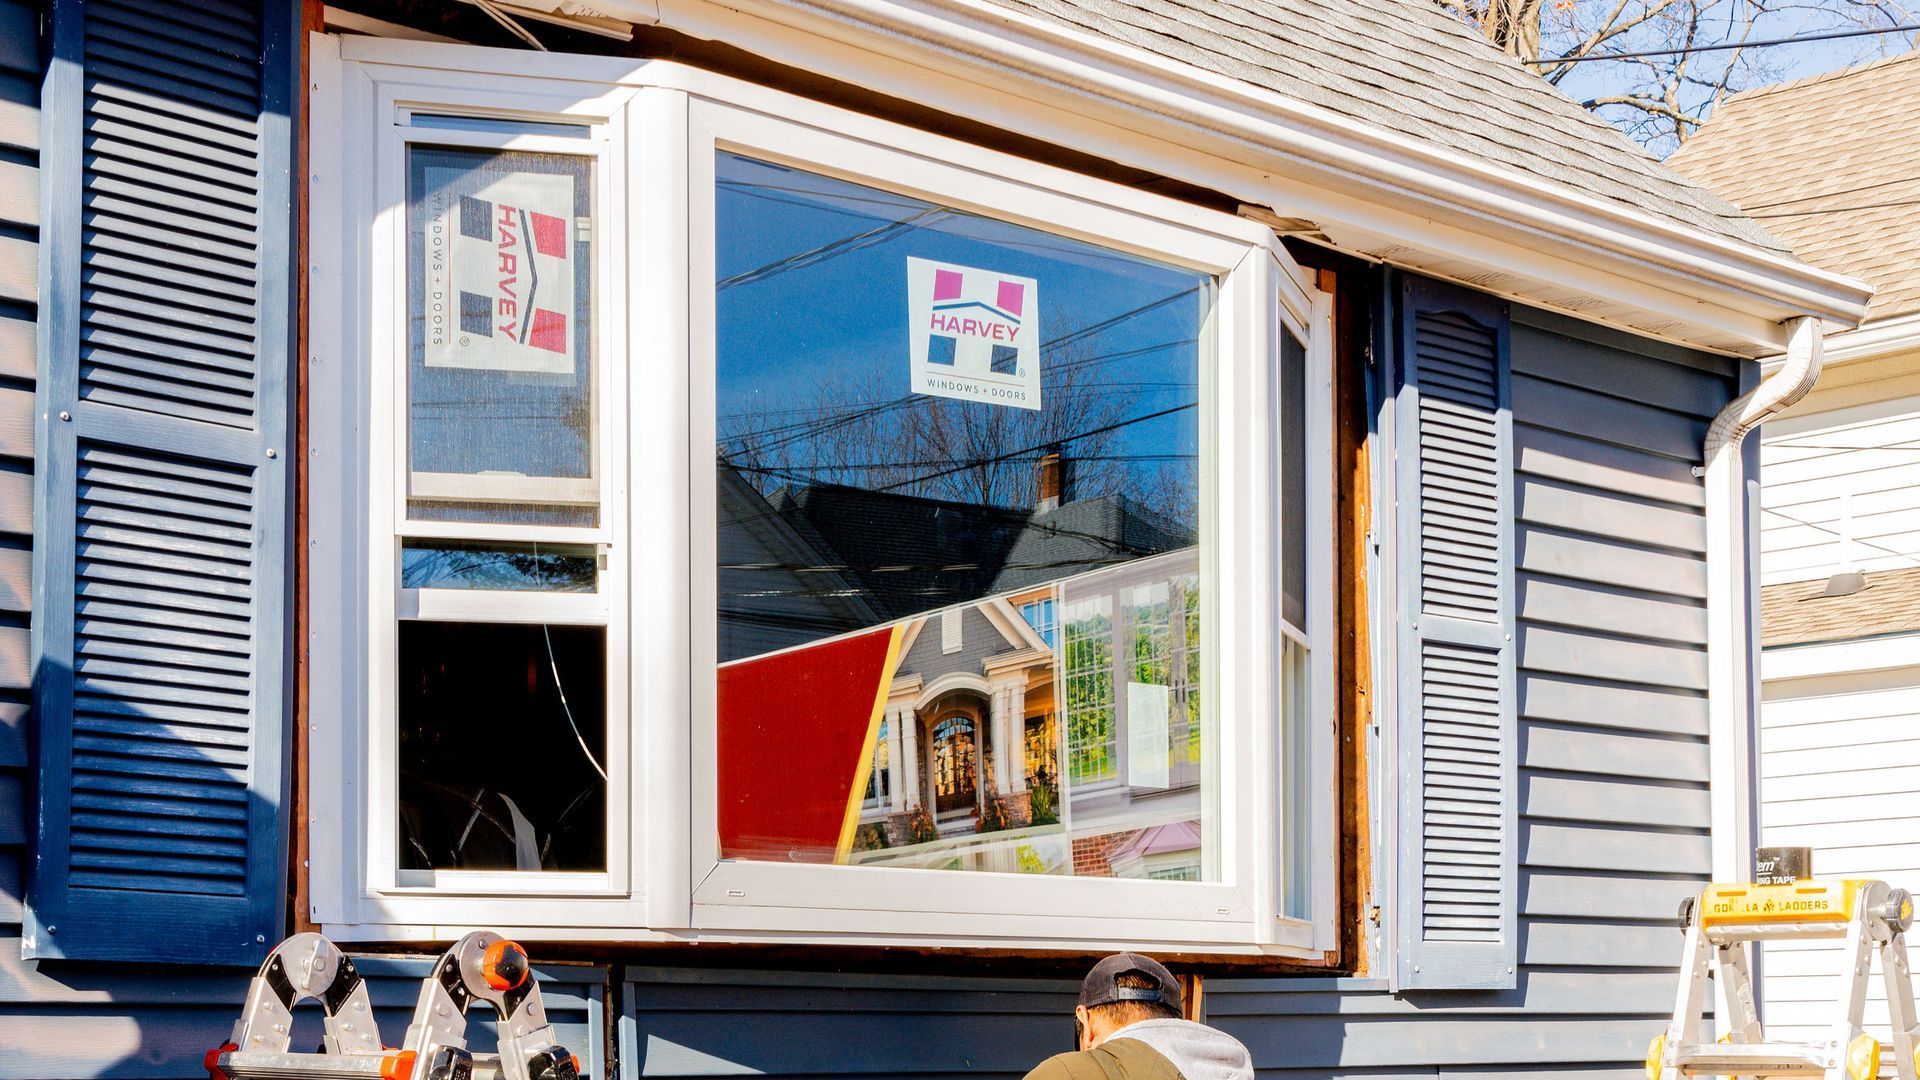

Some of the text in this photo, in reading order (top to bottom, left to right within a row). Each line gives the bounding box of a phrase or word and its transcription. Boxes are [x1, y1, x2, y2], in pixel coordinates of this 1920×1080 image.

[432, 192, 443, 270] WINDOWS
[498, 204, 517, 342] HARVEY
[432, 292, 443, 344] DOORS
[930, 313, 1020, 342] HARVEY
[927, 378, 979, 394] WINDOWS
[991, 388, 1026, 400] DOORS
[1772, 876, 1796, 884] TAPE
[1714, 903, 1759, 912] GORLA
